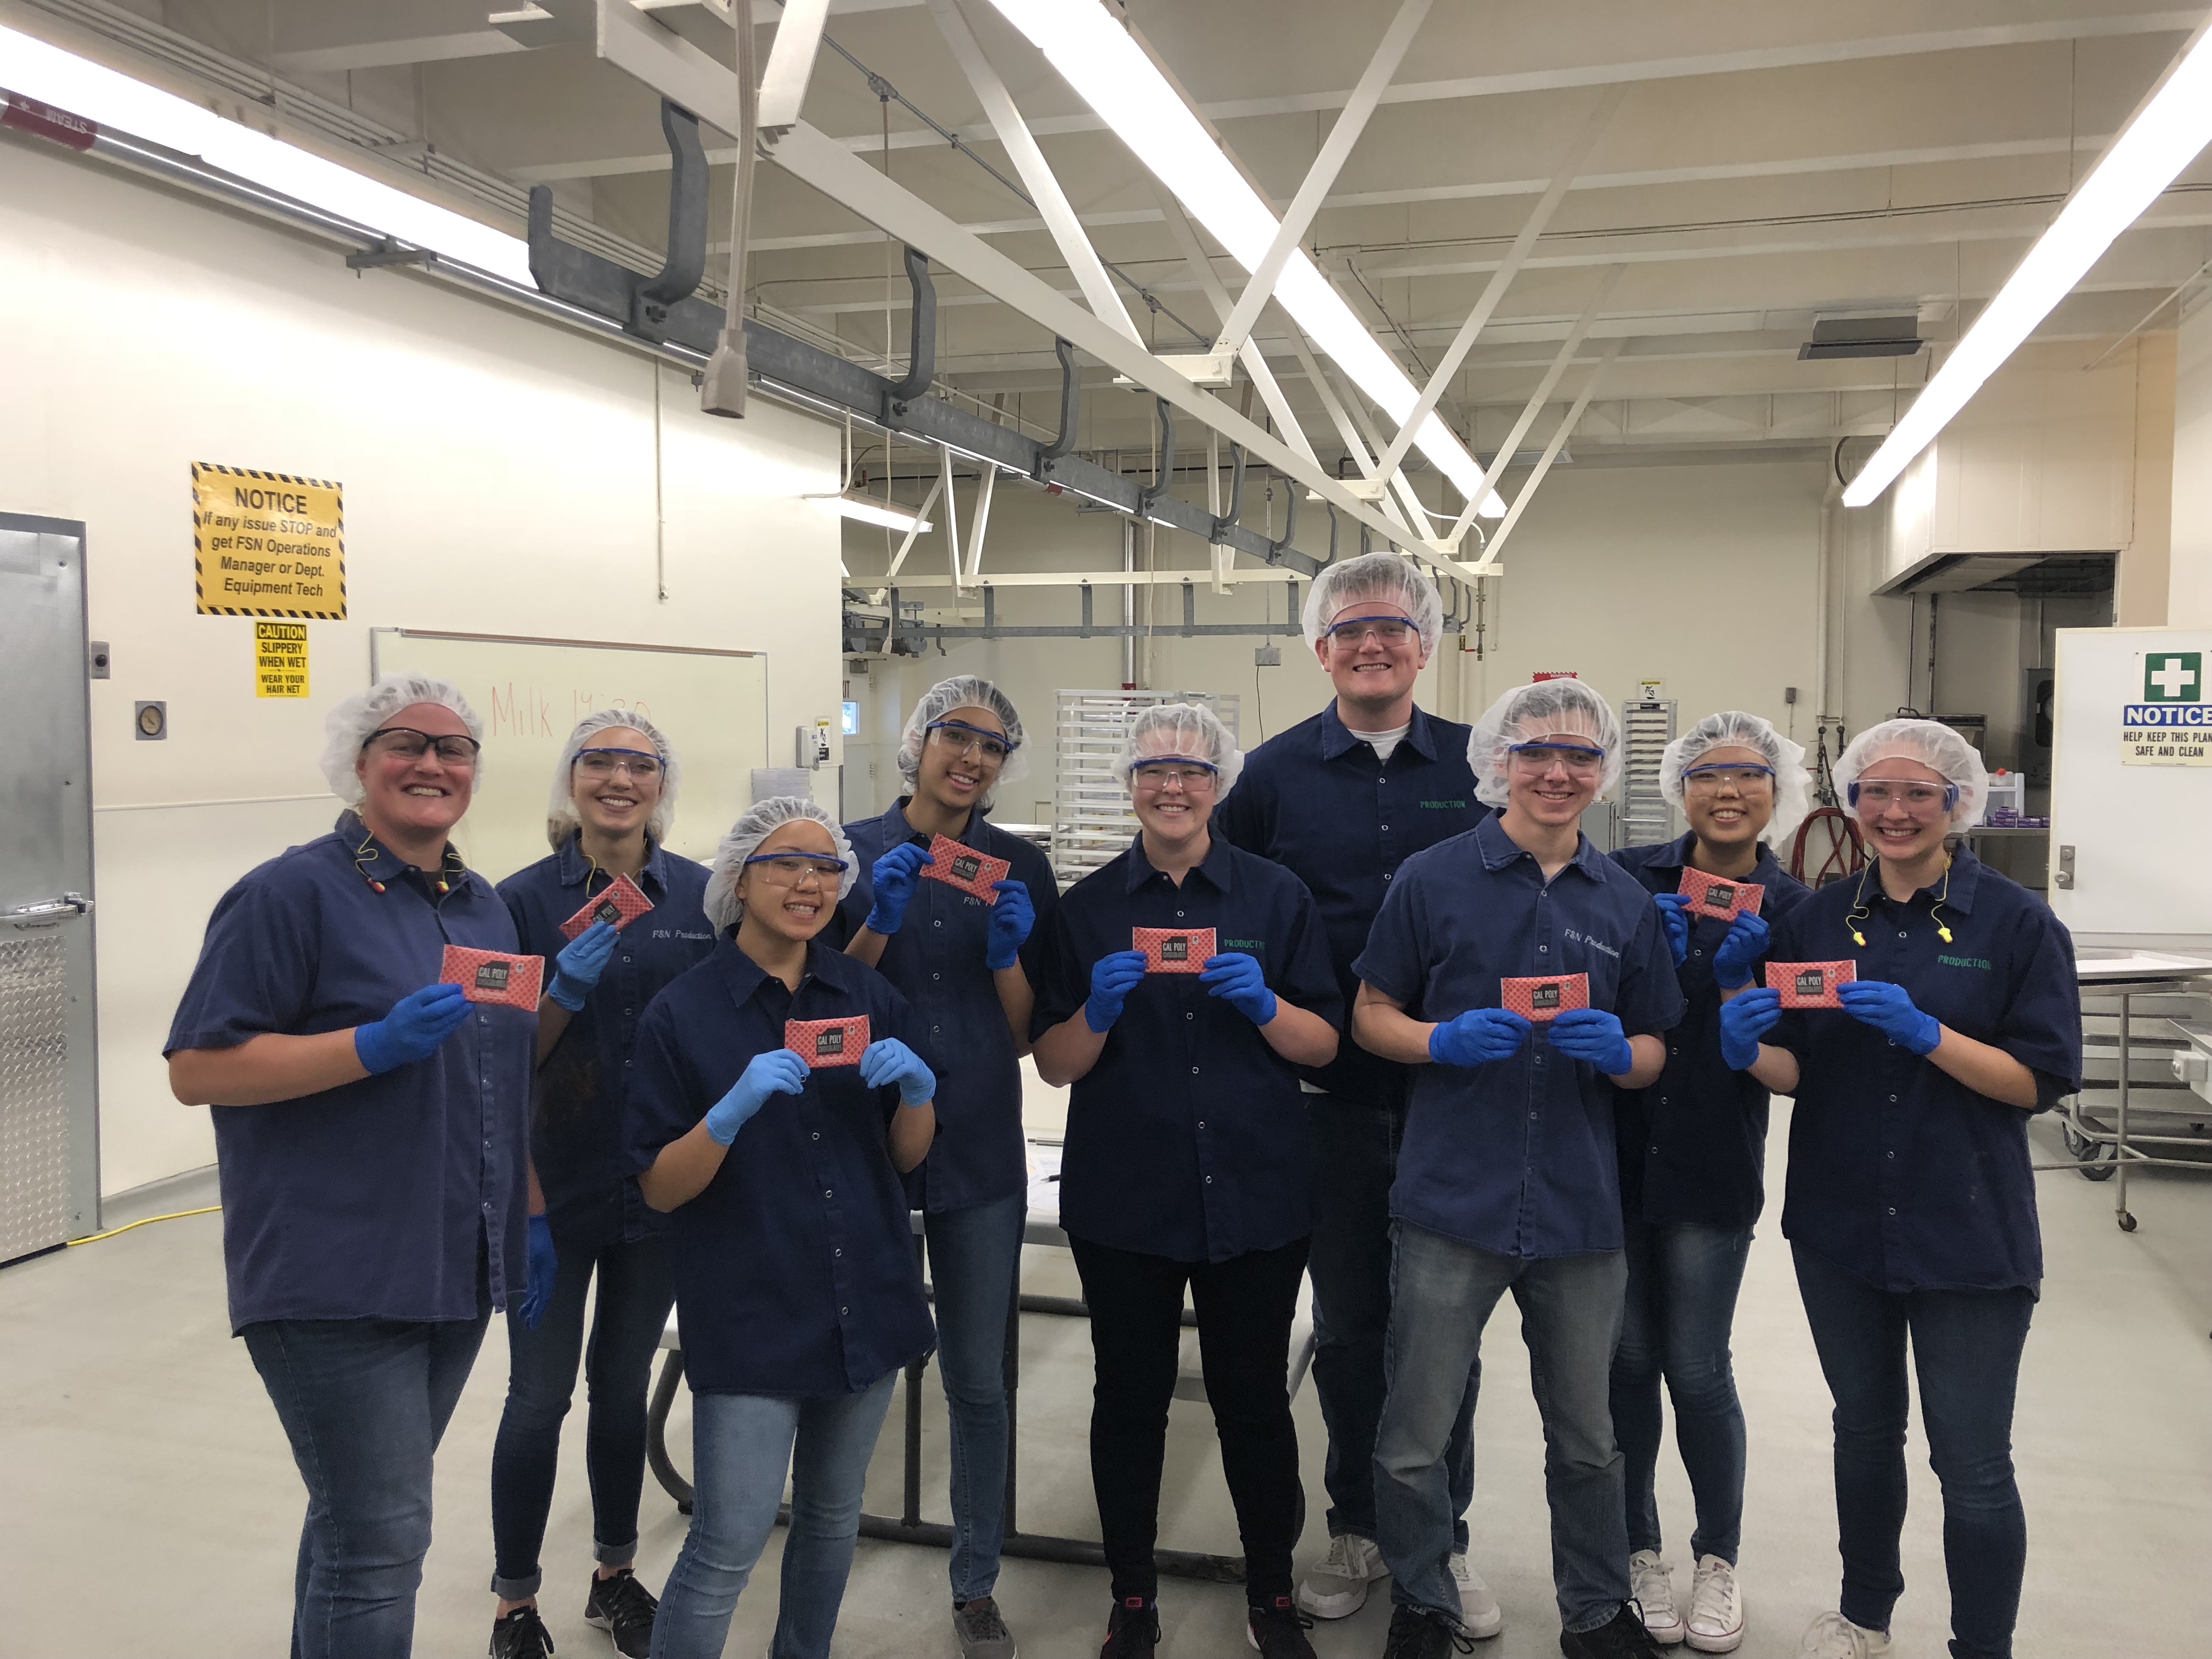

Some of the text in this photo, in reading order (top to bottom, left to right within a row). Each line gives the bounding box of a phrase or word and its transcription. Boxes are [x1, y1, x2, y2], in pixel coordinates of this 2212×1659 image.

[235, 487, 308, 515] NOTICE
[204, 511, 337, 538] If any issue STOP and
[212, 537, 331, 557] get FSN Operations
[221, 556, 325, 577] Manager or Dept.
[224, 578, 323, 597] Equipment Tech
[258, 624, 306, 640] CAUTION
[261, 642, 303, 654] SLIPPERY
[259, 657, 306, 668] WHEN WET
[261, 675, 305, 684] WEAR YOUR
[266, 685, 300, 694] HAIR NET
[492, 682, 553, 738] Milk
[2123, 732, 2143, 742] HELP
[2147, 732, 2167, 742] KEEP
[2171, 732, 2189, 743] THIS
[2135, 746, 2204, 757] SAFE AND CLEAN
[1420, 800, 1466, 809] PRODUCTION
[955, 857, 965, 868] CAL
[675, 929, 712, 939] Production
[1163, 943, 1186, 951] CAL POLY
[478, 967, 508, 979] CAL POLY
[1797, 976, 1822, 986] CAL POLY
[1533, 990, 1543, 999] CAL
[817, 1034, 843, 1046] CAL POLY
